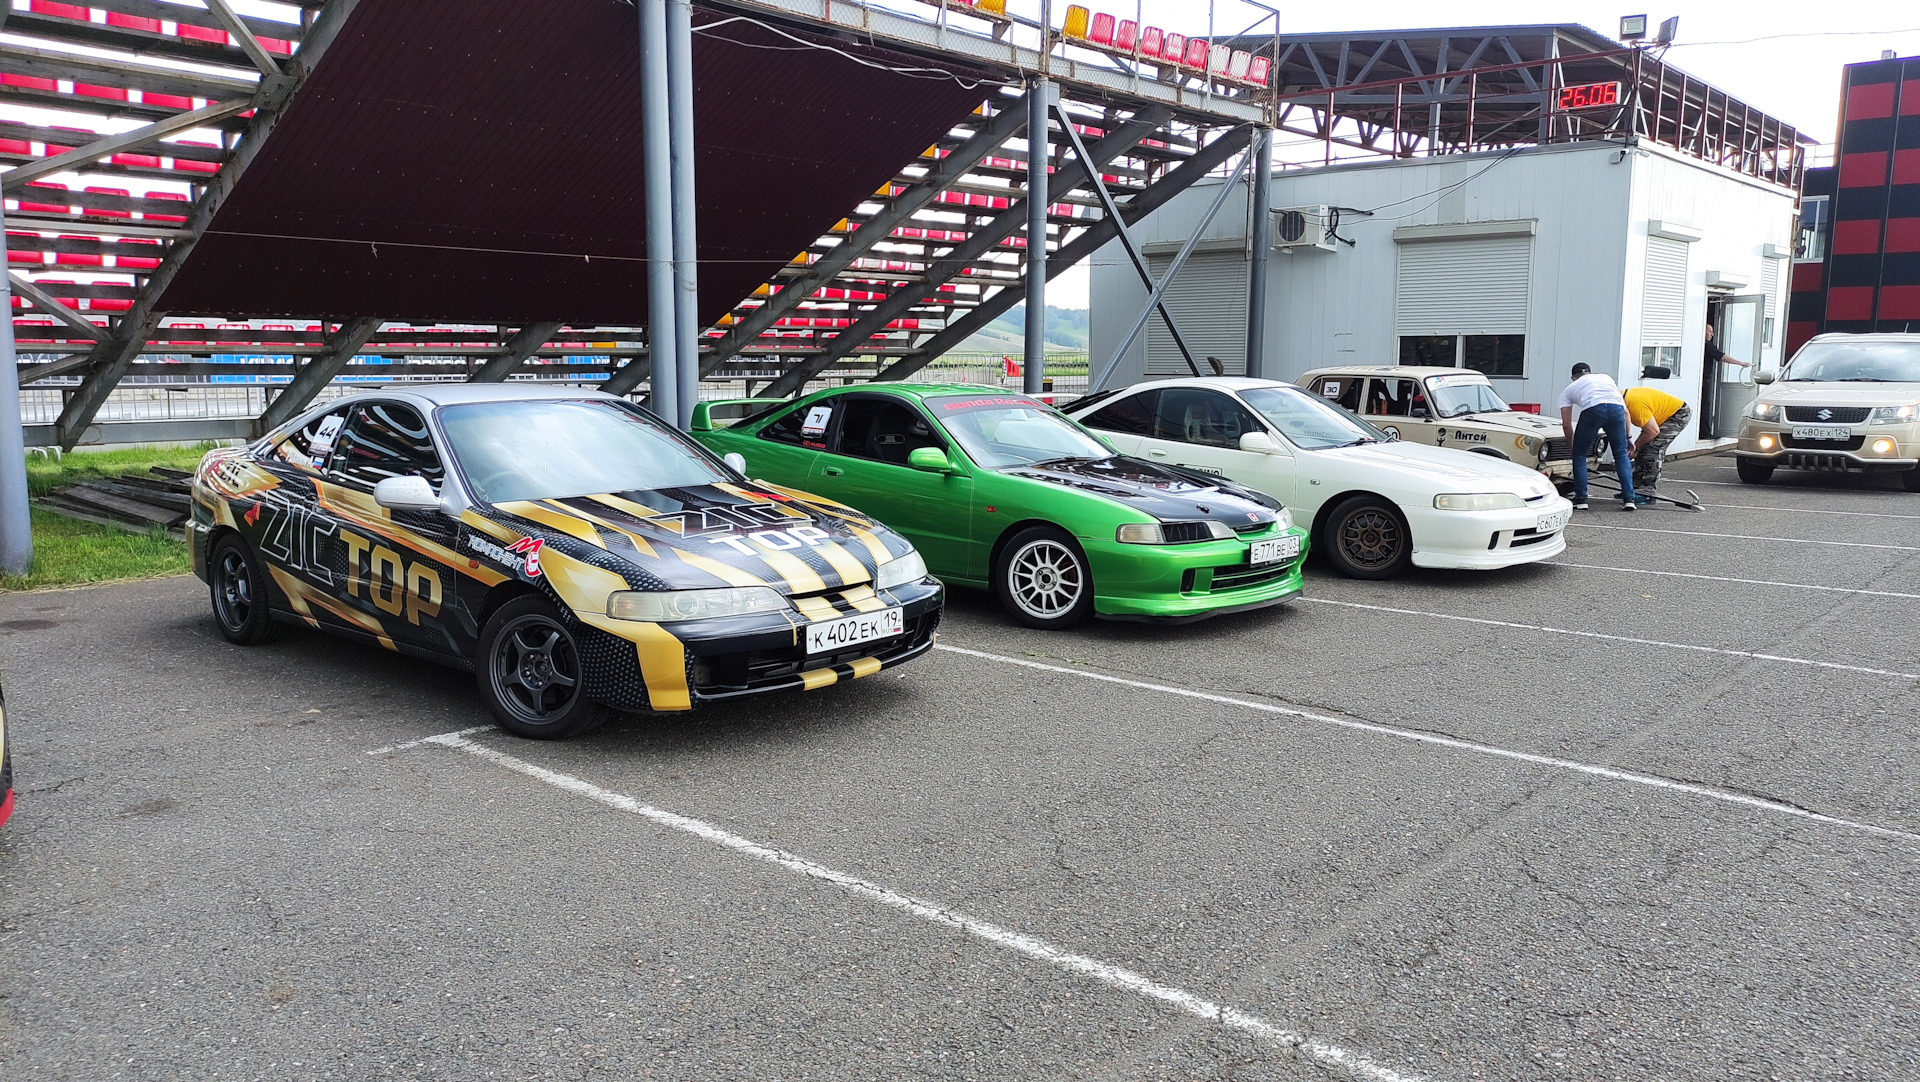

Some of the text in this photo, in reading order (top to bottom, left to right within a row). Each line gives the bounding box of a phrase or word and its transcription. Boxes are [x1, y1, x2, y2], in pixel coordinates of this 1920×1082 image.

[1560, 83, 1616, 109] 26.06
[943, 398, 1041, 411] Honda Racing
[813, 413, 824, 424] 71
[319, 425, 337, 439] 44
[1454, 430, 1487, 442] Антей
[640, 502, 816, 539] ZIC
[706, 526, 830, 556] TOP
[1288, 538, 1297, 549] 03
[260, 489, 442, 626] ZIC TOP
[883, 611, 898, 628] 19
